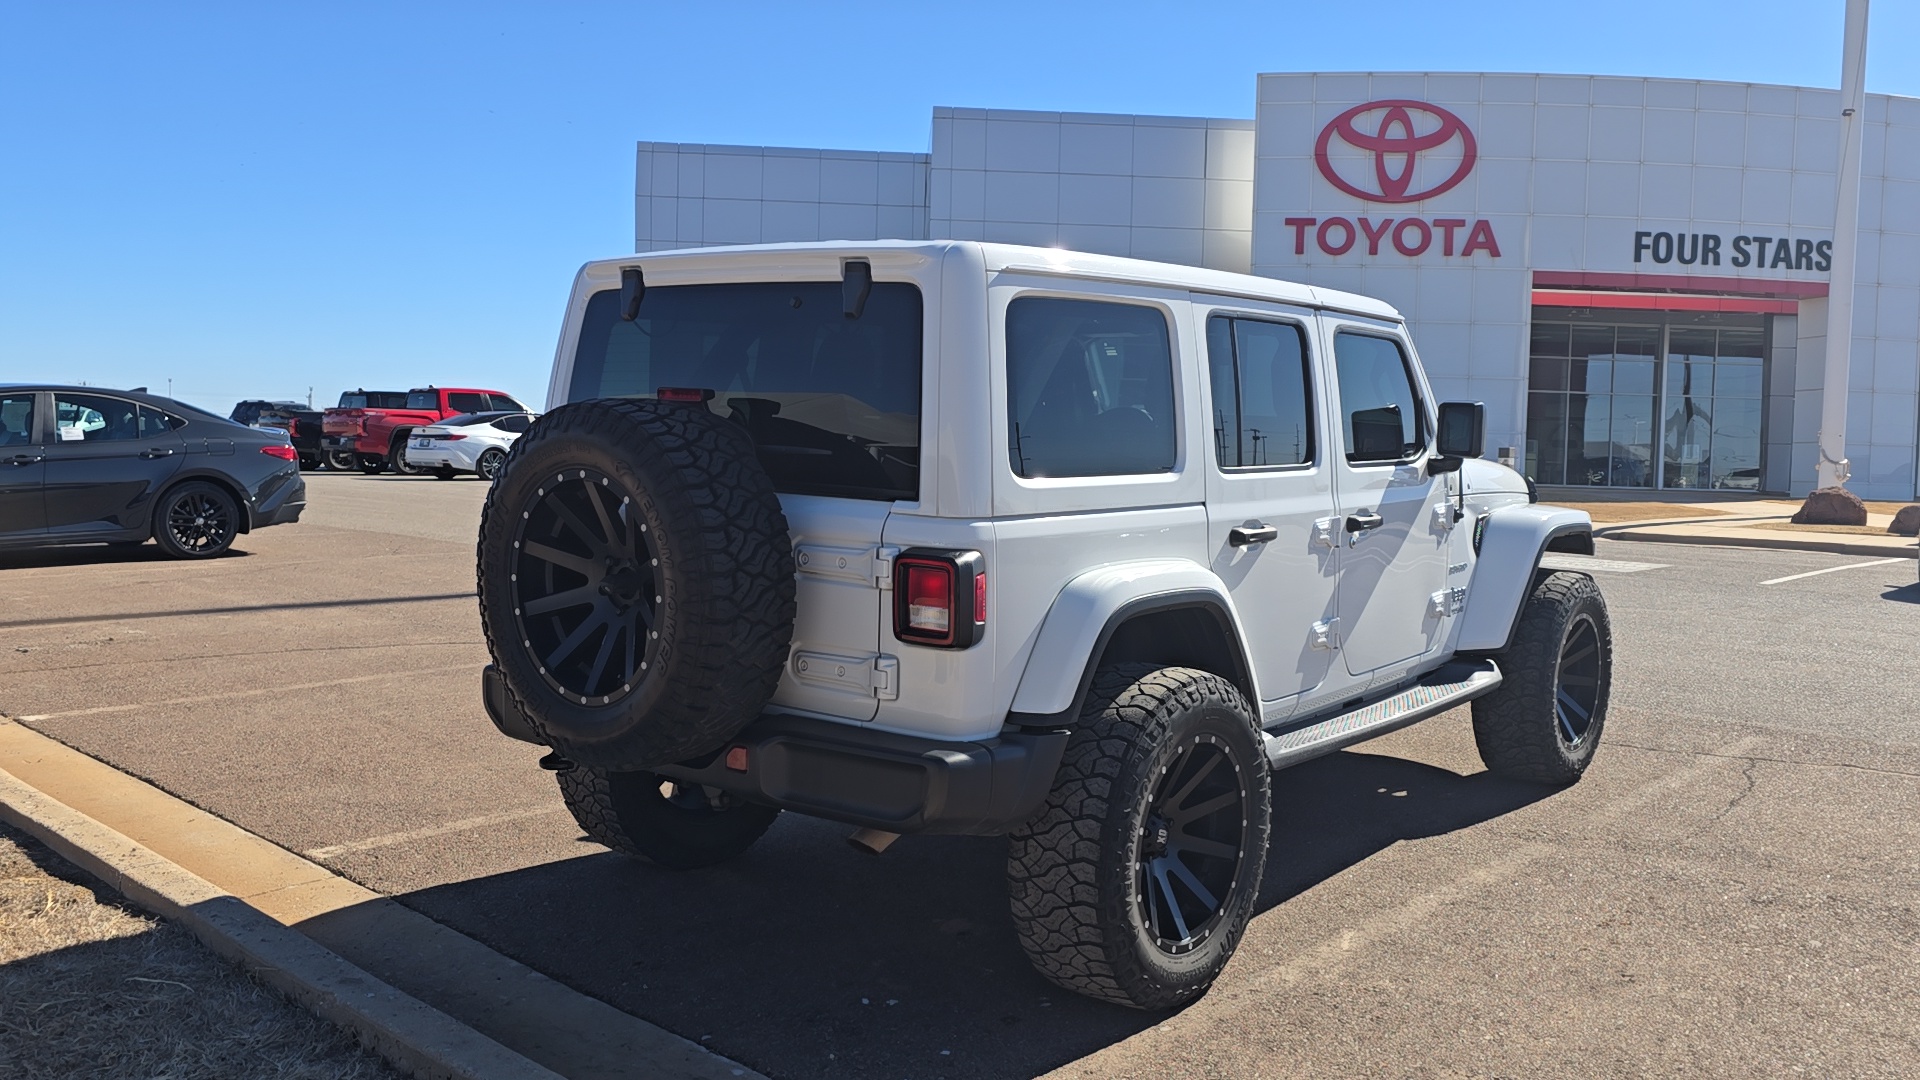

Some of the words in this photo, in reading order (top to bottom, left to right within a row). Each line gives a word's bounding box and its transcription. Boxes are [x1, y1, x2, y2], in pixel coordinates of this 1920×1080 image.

[1285, 217, 1501, 257] TOYOTA
[1634, 231, 1721, 266] FOUR
[1732, 235, 1832, 271] STARS
[633, 480, 674, 568] VENOM
[656, 577, 678, 676] POWER
[1156, 828, 1168, 845] XD
